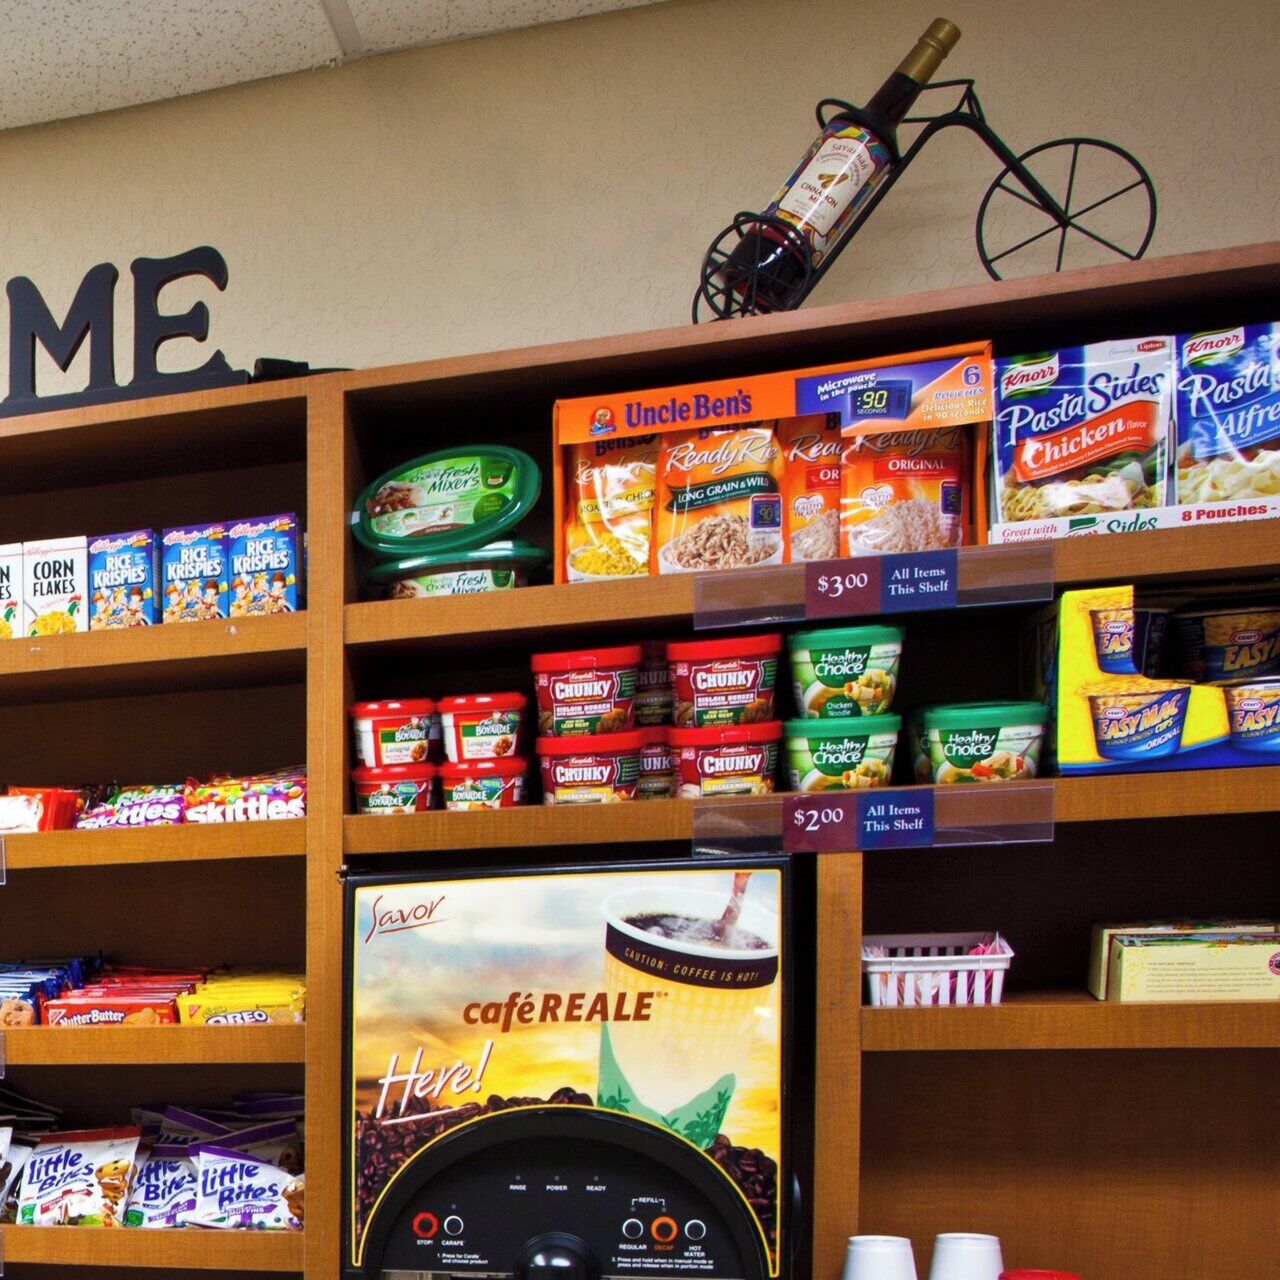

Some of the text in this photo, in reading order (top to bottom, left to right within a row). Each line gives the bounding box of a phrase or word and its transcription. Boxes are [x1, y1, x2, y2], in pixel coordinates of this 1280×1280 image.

[1186, 332, 1240, 357] Knorr
[817, 372, 877, 395] Microwave
[962, 365, 983, 386] 6
[1005, 365, 1056, 391] Knorr
[934, 387, 984, 400] POUCHES
[1178, 363, 1270, 417] Pasta
[625, 389, 752, 429] Uncle Ben's
[921, 398, 988, 413] Delicious Rice
[998, 362, 1165, 447] Pasta Sides
[1023, 416, 1125, 469] Chicken
[1126, 419, 1148, 431] flavor
[439, 463, 478, 480] Fresh
[427, 474, 481, 495] Mixers
[1182, 504, 1268, 521] 8 Pouches
[1002, 523, 1057, 538] Great with
[105, 555, 132, 572] RICE
[180, 547, 207, 565] RICE
[33, 558, 74, 581] CORN
[93, 568, 146, 590] KRISPIES
[167, 560, 221, 582] KRISPIES
[891, 565, 946, 581] All Items
[33, 579, 76, 597] FLAKES
[888, 579, 950, 595] This Shelf
[820, 650, 867, 668] Healthy
[554, 680, 612, 700] CHUNKY
[696, 670, 757, 691] CHUNKY
[827, 709, 852, 718] Noodle
[475, 722, 511, 737] BOYARDEE
[185, 794, 307, 823] Skittles
[866, 803, 921, 816] All Items
[863, 817, 924, 832] This Shelf
[365, 894, 446, 944] Savor
[624, 947, 760, 982] CAUTION: COFFEE IS HOT!
[375, 1039, 493, 1120] Here!
[29, 1149, 83, 1185] Little
[201, 1163, 259, 1197] Little
